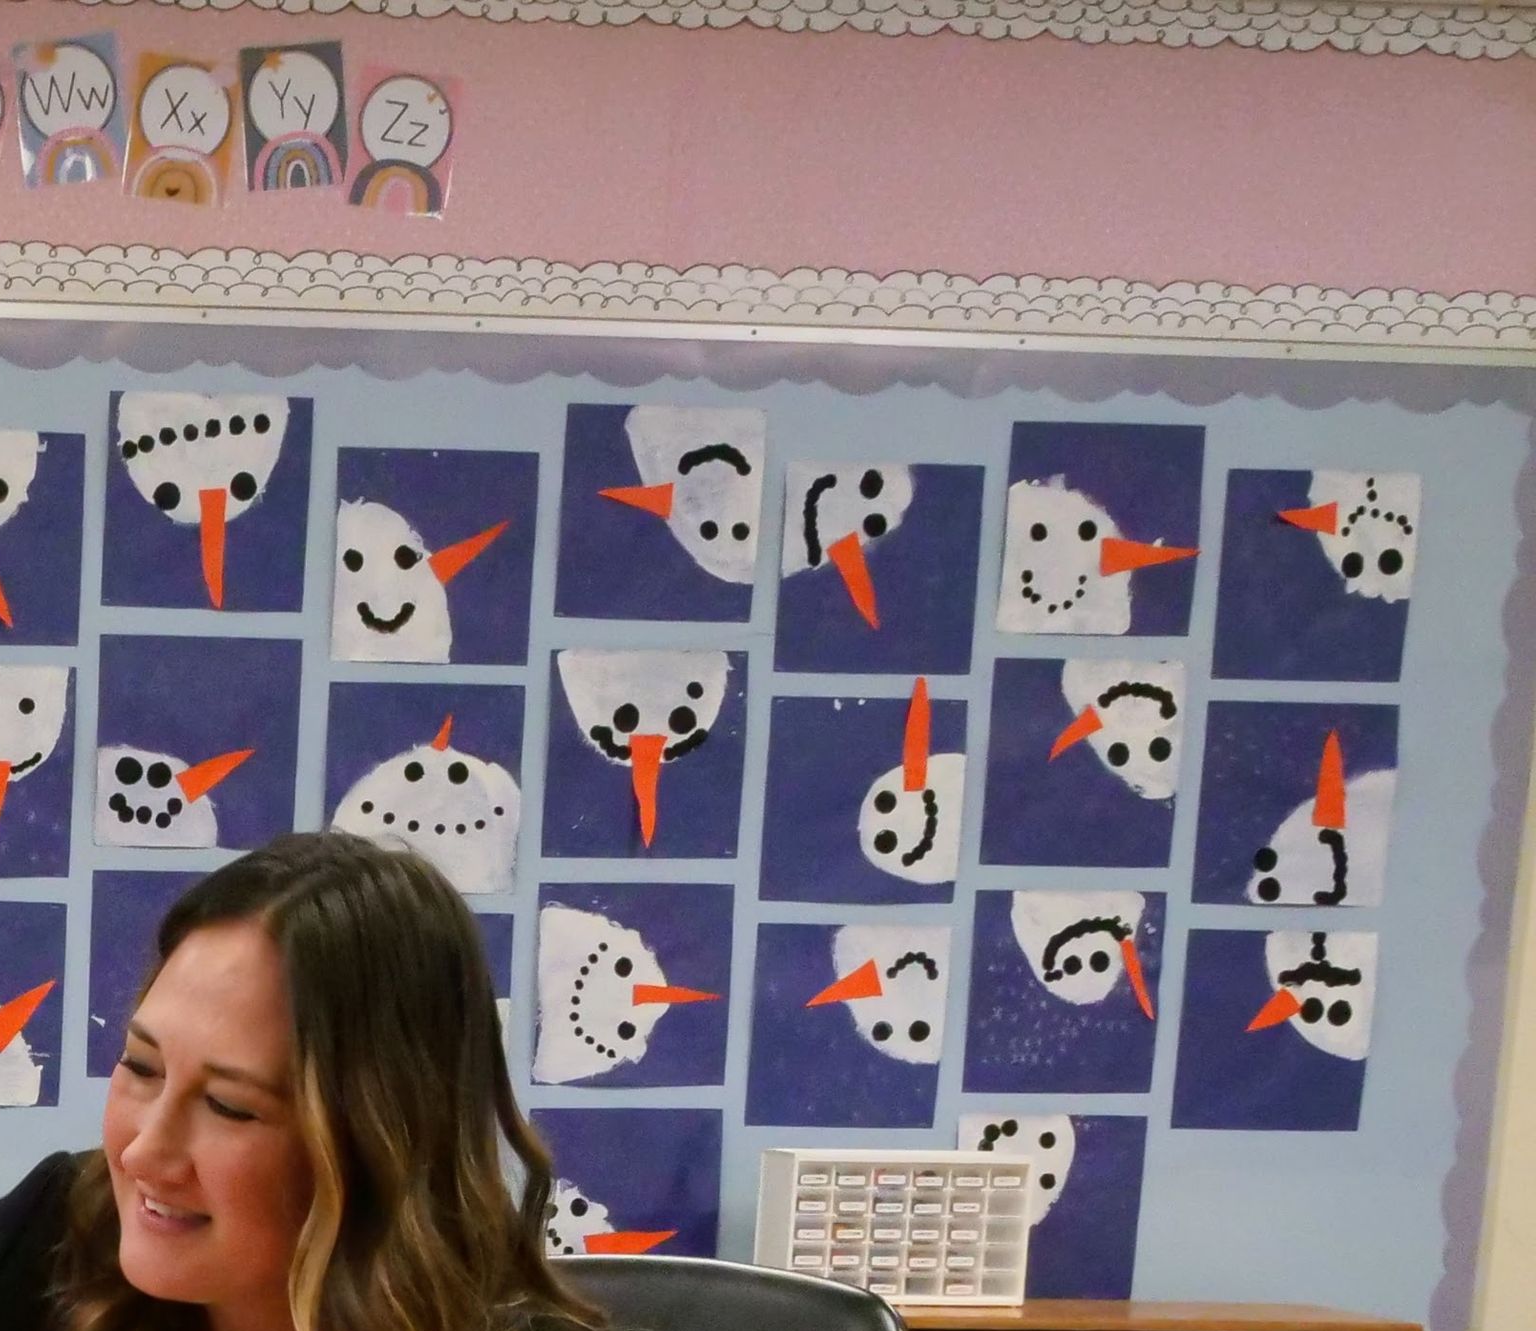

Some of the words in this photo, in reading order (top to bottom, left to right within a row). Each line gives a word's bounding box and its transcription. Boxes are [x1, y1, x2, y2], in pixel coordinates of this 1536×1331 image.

[27, 75, 109, 117] Ww
[160, 90, 208, 135] Xx
[268, 78, 315, 129] Yy
[381, 100, 428, 148] Zz
